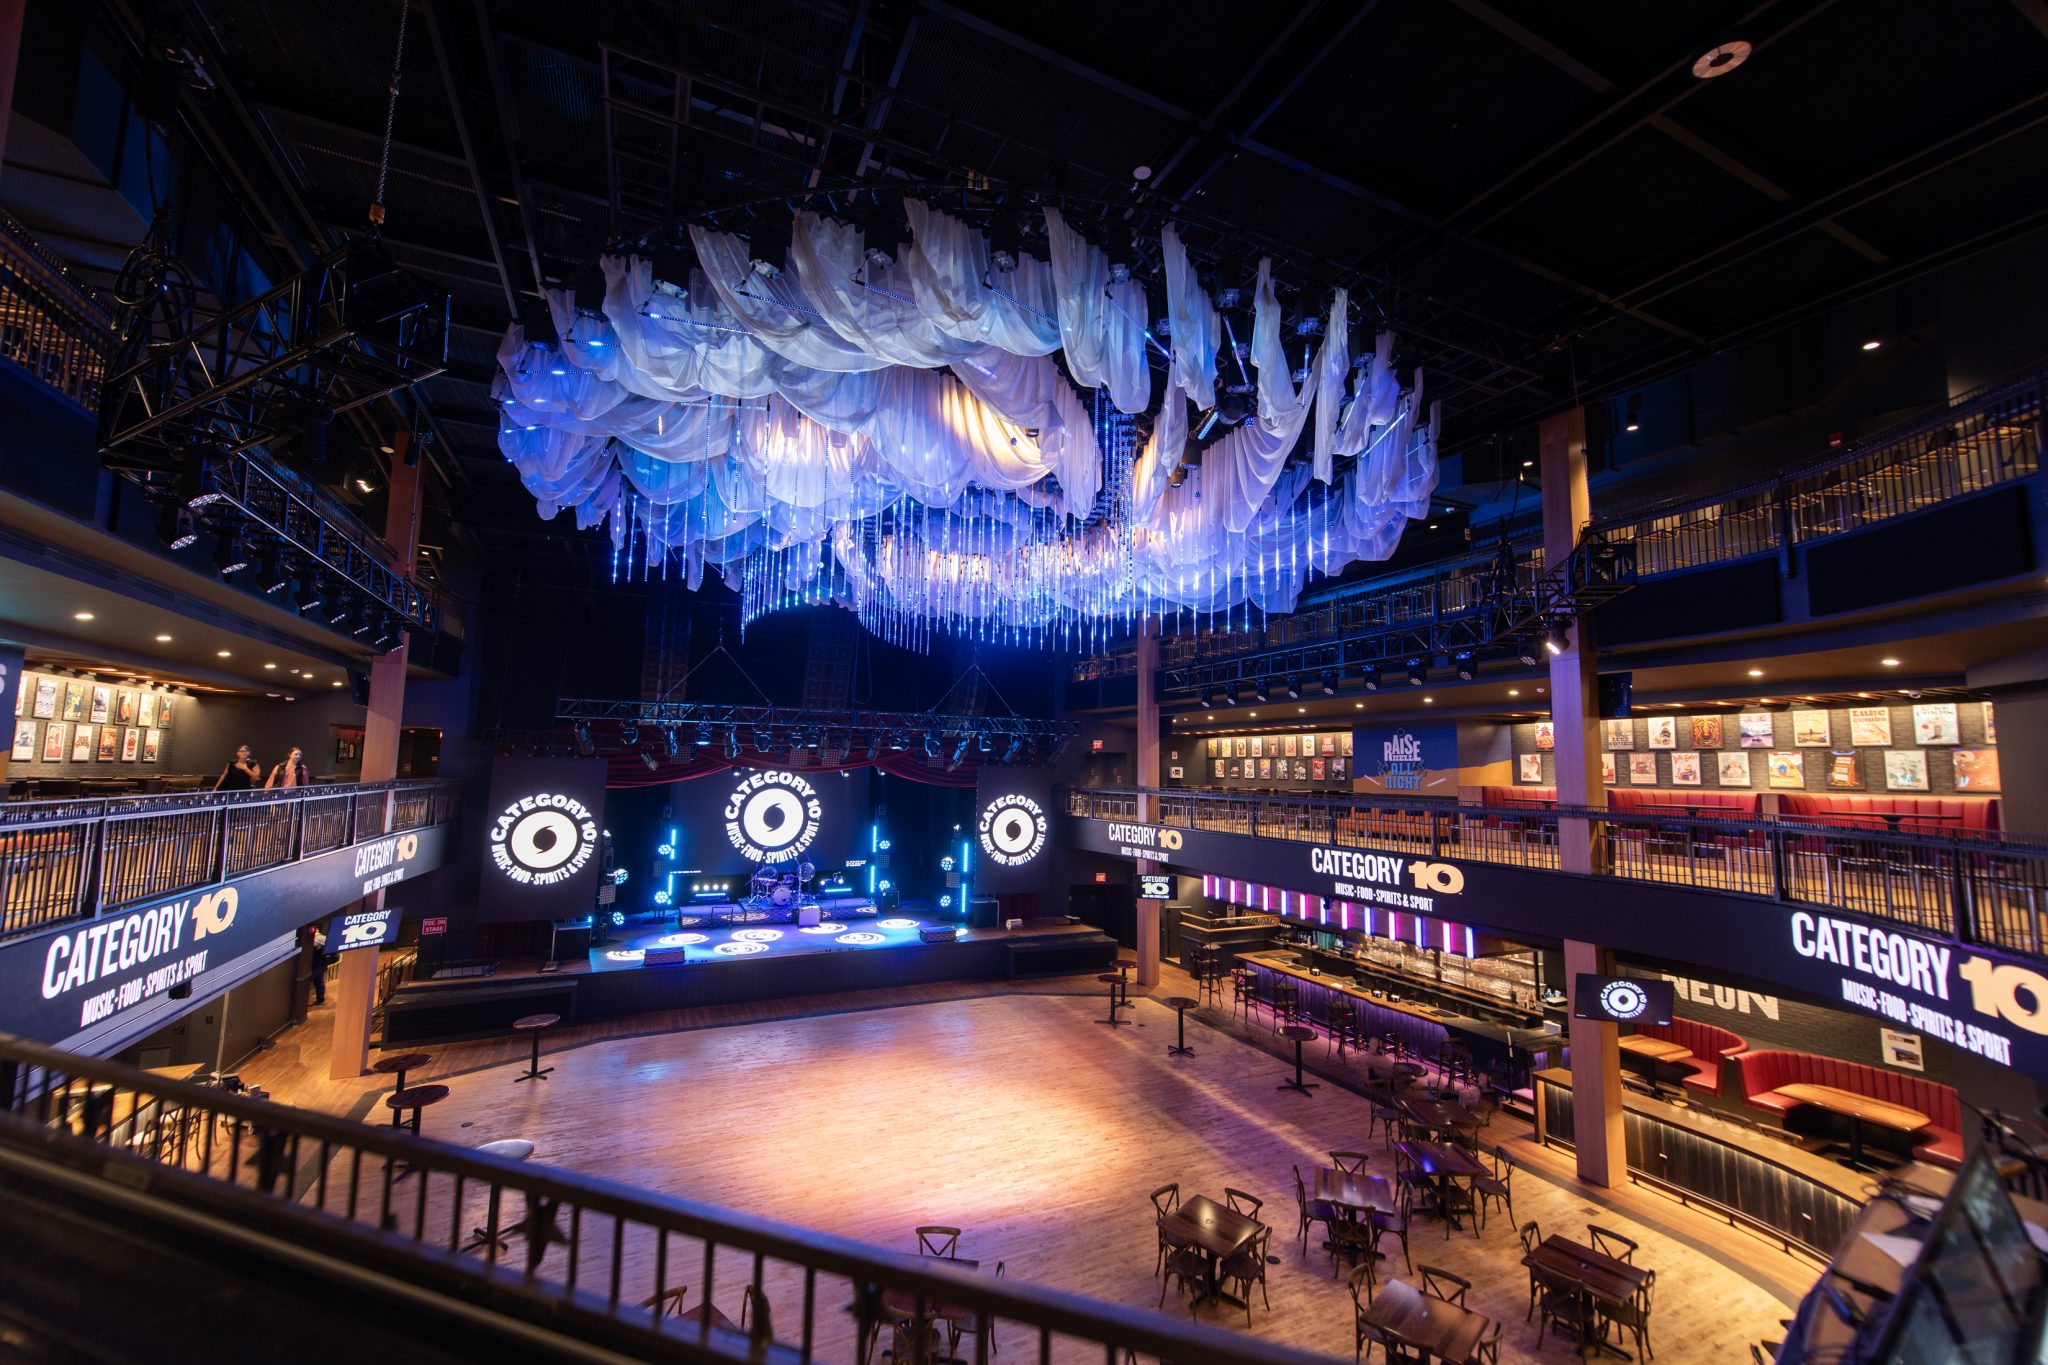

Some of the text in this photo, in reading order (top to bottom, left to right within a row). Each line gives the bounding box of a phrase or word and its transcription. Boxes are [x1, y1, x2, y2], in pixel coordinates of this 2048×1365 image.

[1384, 734, 1421, 761] RAISE
[1385, 775, 1421, 790] NIGHT
[1391, 762, 1414, 776] ALL
[725, 770, 816, 820] CATEGORY
[491, 793, 592, 842] CATEGORY
[980, 794, 1043, 832] CATEGORY
[725, 821, 746, 848] MUSIC
[741, 844, 763, 862] FOOD
[765, 846, 798, 863] SPIRITS
[800, 821, 820, 846] SPORT
[1108, 823, 1183, 850] CATEGORY 10
[355, 833, 418, 878] CATEGORY 10
[1311, 847, 1465, 894] CATEGORY 10
[1141, 875, 1170, 883] CATEGORY
[1141, 882, 1170, 895] 10
[1334, 882, 1354, 897] MUSIC
[1356, 886, 1374, 900] FOOD
[1375, 889, 1402, 905] SPIRITS
[1409, 895, 1433, 912] SPORT
[341, 921, 387, 944] 10
[344, 910, 392, 926] CATEGORY
[41, 886, 239, 999] CATEGORY 10
[80, 950, 208, 1028] MUSIC FOOD SPIRITS & SPORT
[1600, 980, 1645, 999] CATEGORY
[1791, 911, 2048, 1036] CATEGORY 10
[1841, 977, 2011, 1067] MUSIC FOOD SPIRITS & SPORT
